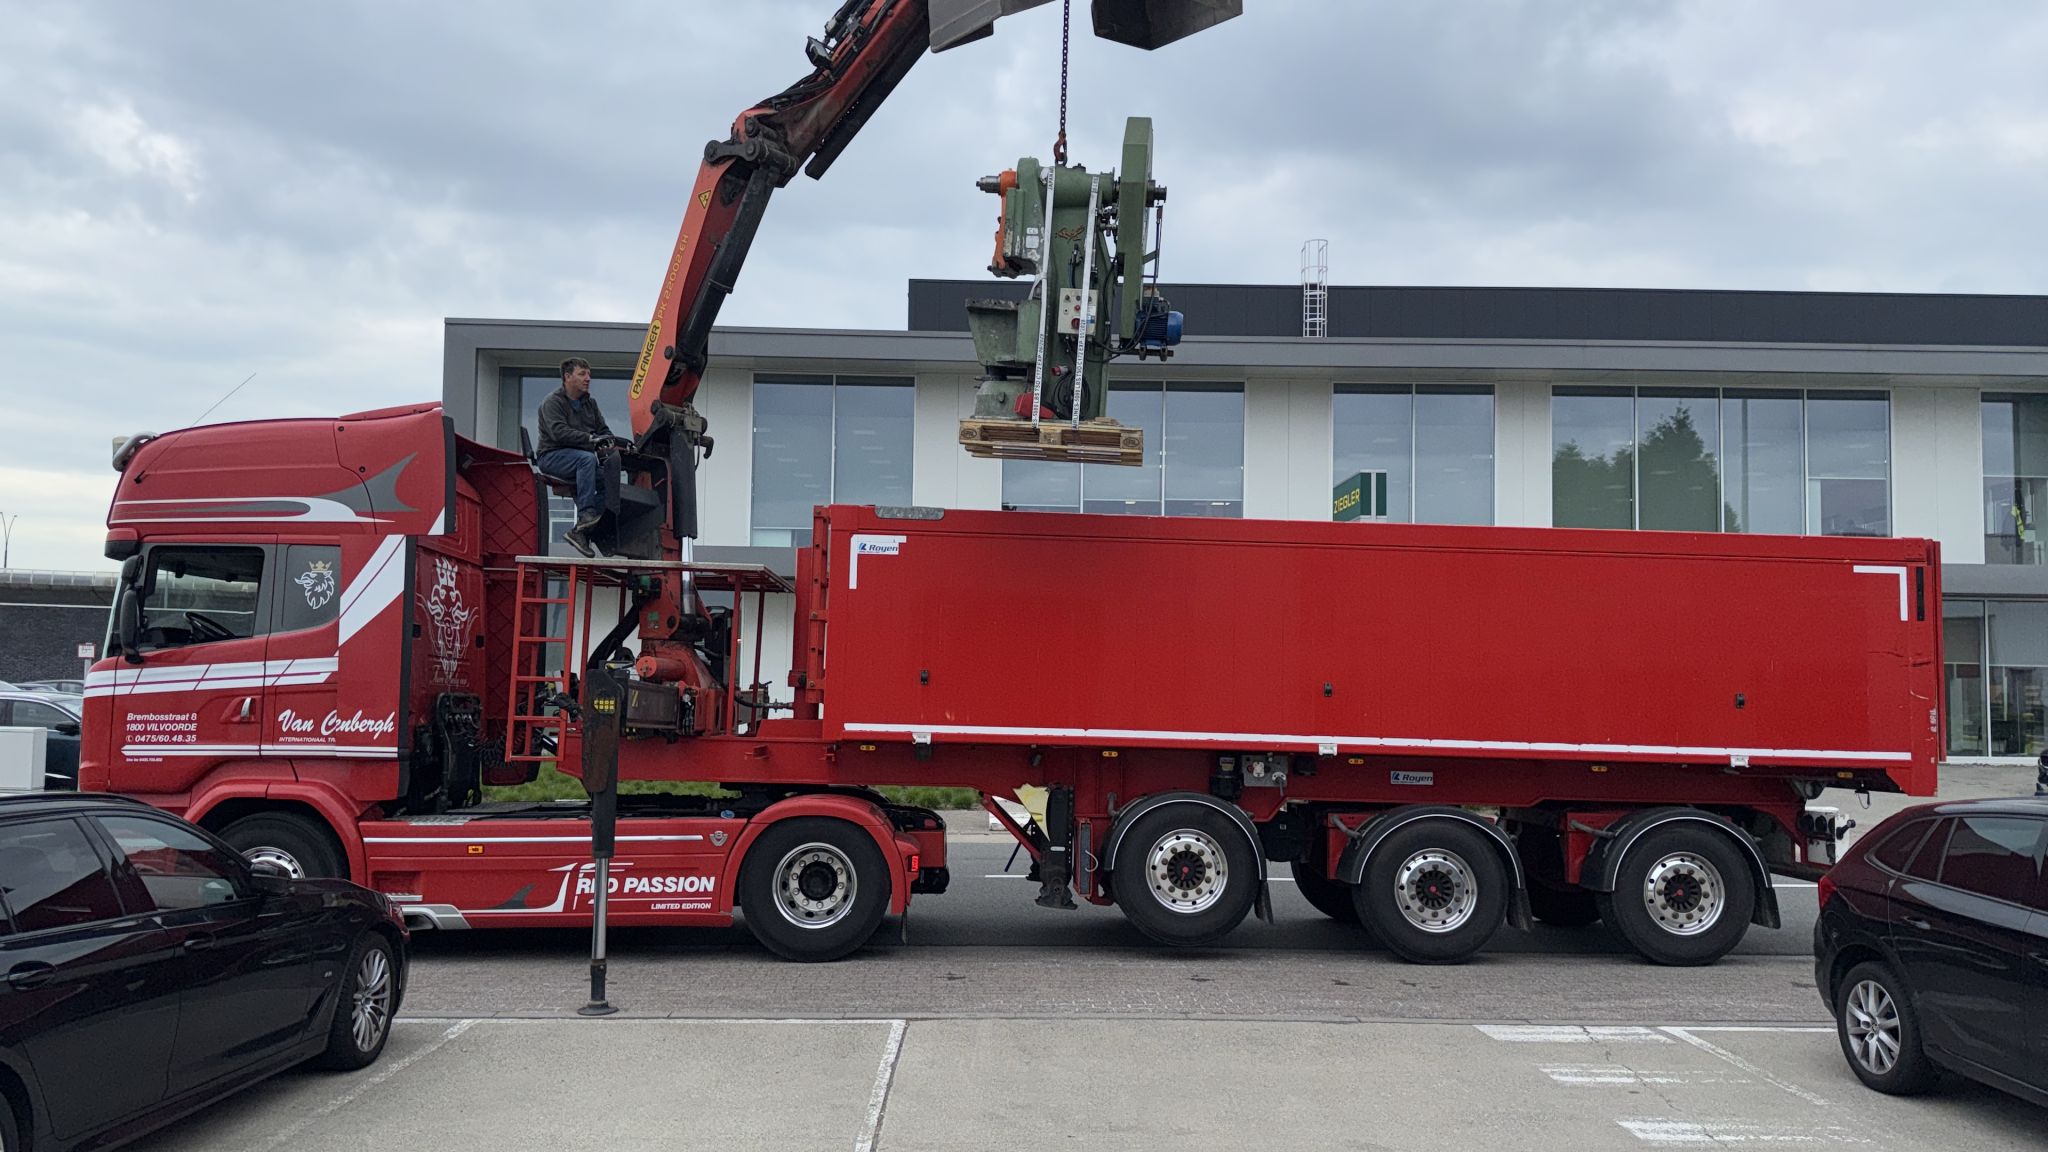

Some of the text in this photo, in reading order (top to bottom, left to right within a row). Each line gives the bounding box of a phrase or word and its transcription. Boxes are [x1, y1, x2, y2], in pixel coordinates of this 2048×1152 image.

[632, 324, 660, 395] PALFINGER
[1333, 488, 1360, 514] ZIEGLER
[868, 544, 898, 553] Royen
[126, 712, 198, 721] Brembosstraat 8
[278, 709, 315, 732] Van
[126, 723, 198, 731] 1800 VILVOORDE
[134, 734, 197, 743] 0475/60.48.35
[623, 876, 715, 894] PASSION
[681, 902, 712, 910] EDITION
